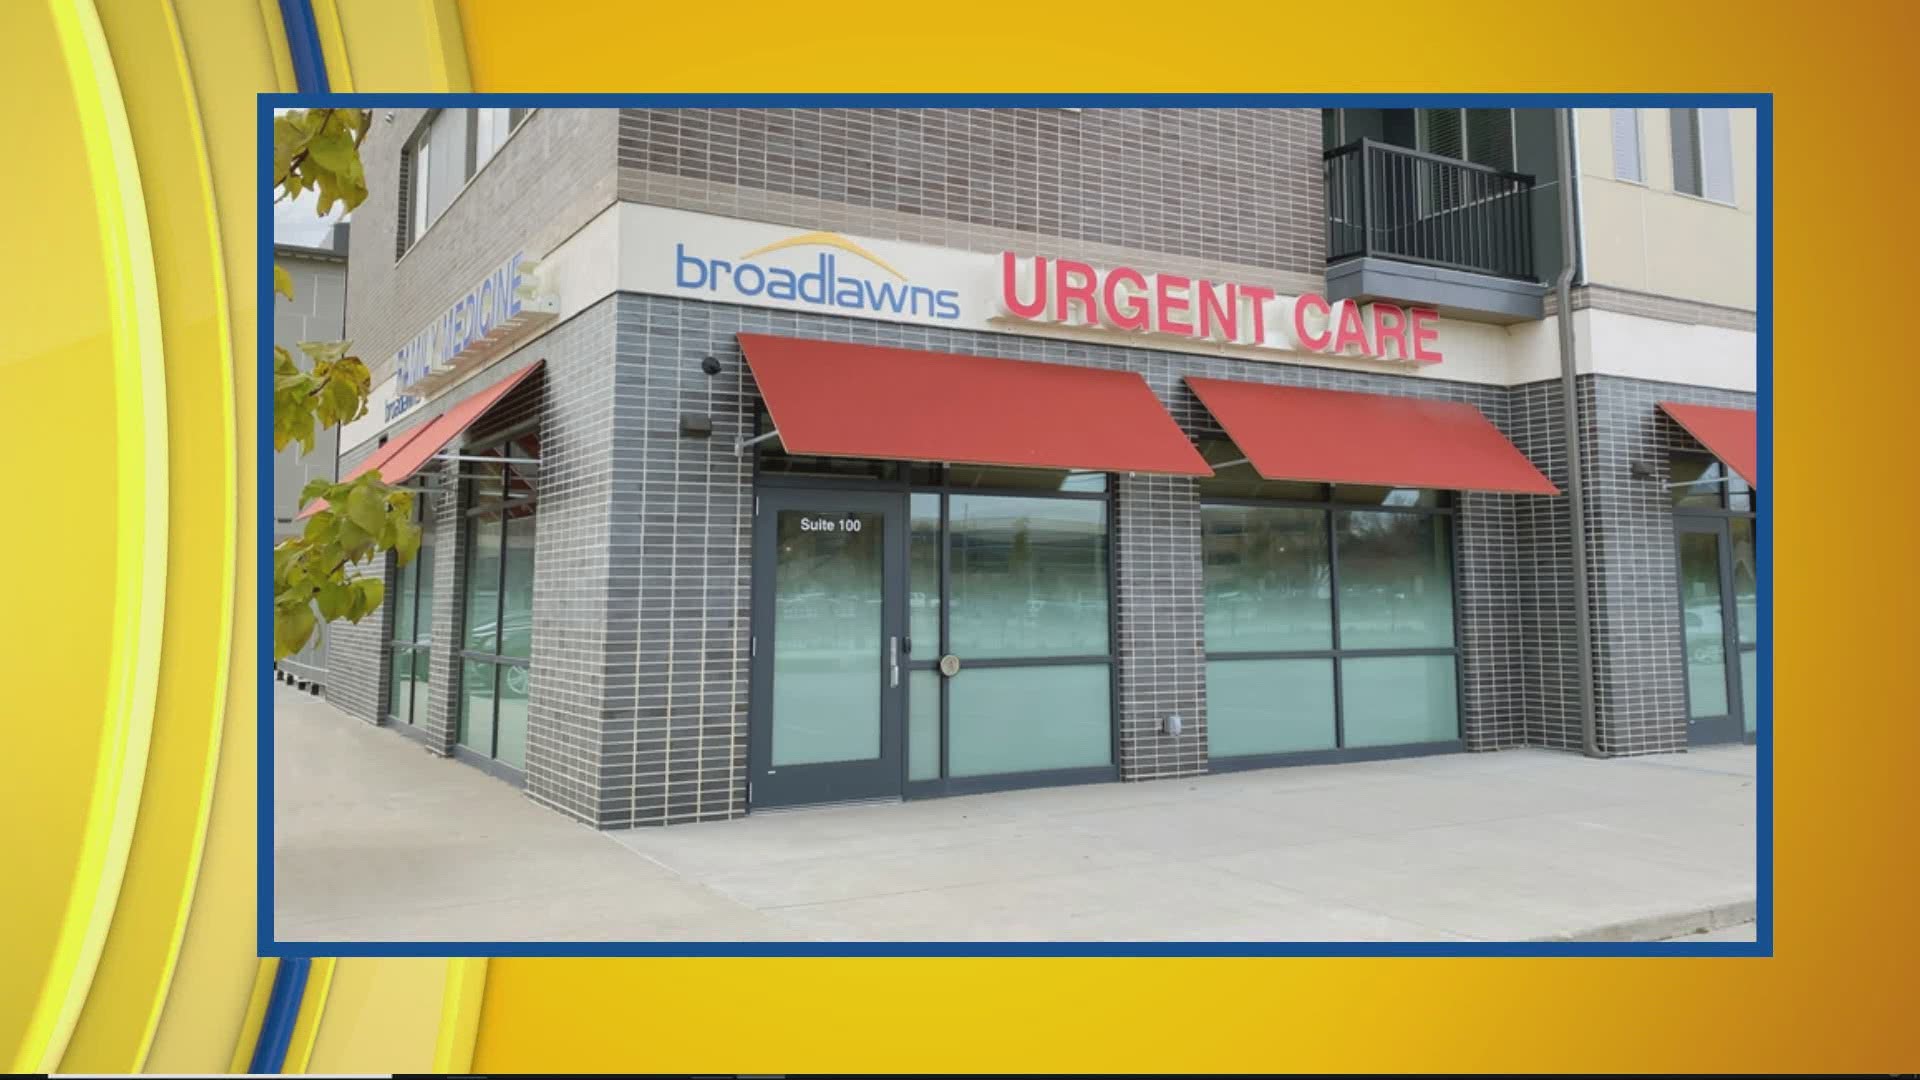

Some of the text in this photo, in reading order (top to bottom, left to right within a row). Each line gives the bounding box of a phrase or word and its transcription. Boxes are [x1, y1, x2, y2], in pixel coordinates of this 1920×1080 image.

[441, 250, 523, 364] MEDICINE
[676, 243, 960, 319] broadlawns
[1003, 251, 1443, 364] URGENT CARE
[800, 517, 861, 531] Suite 100
